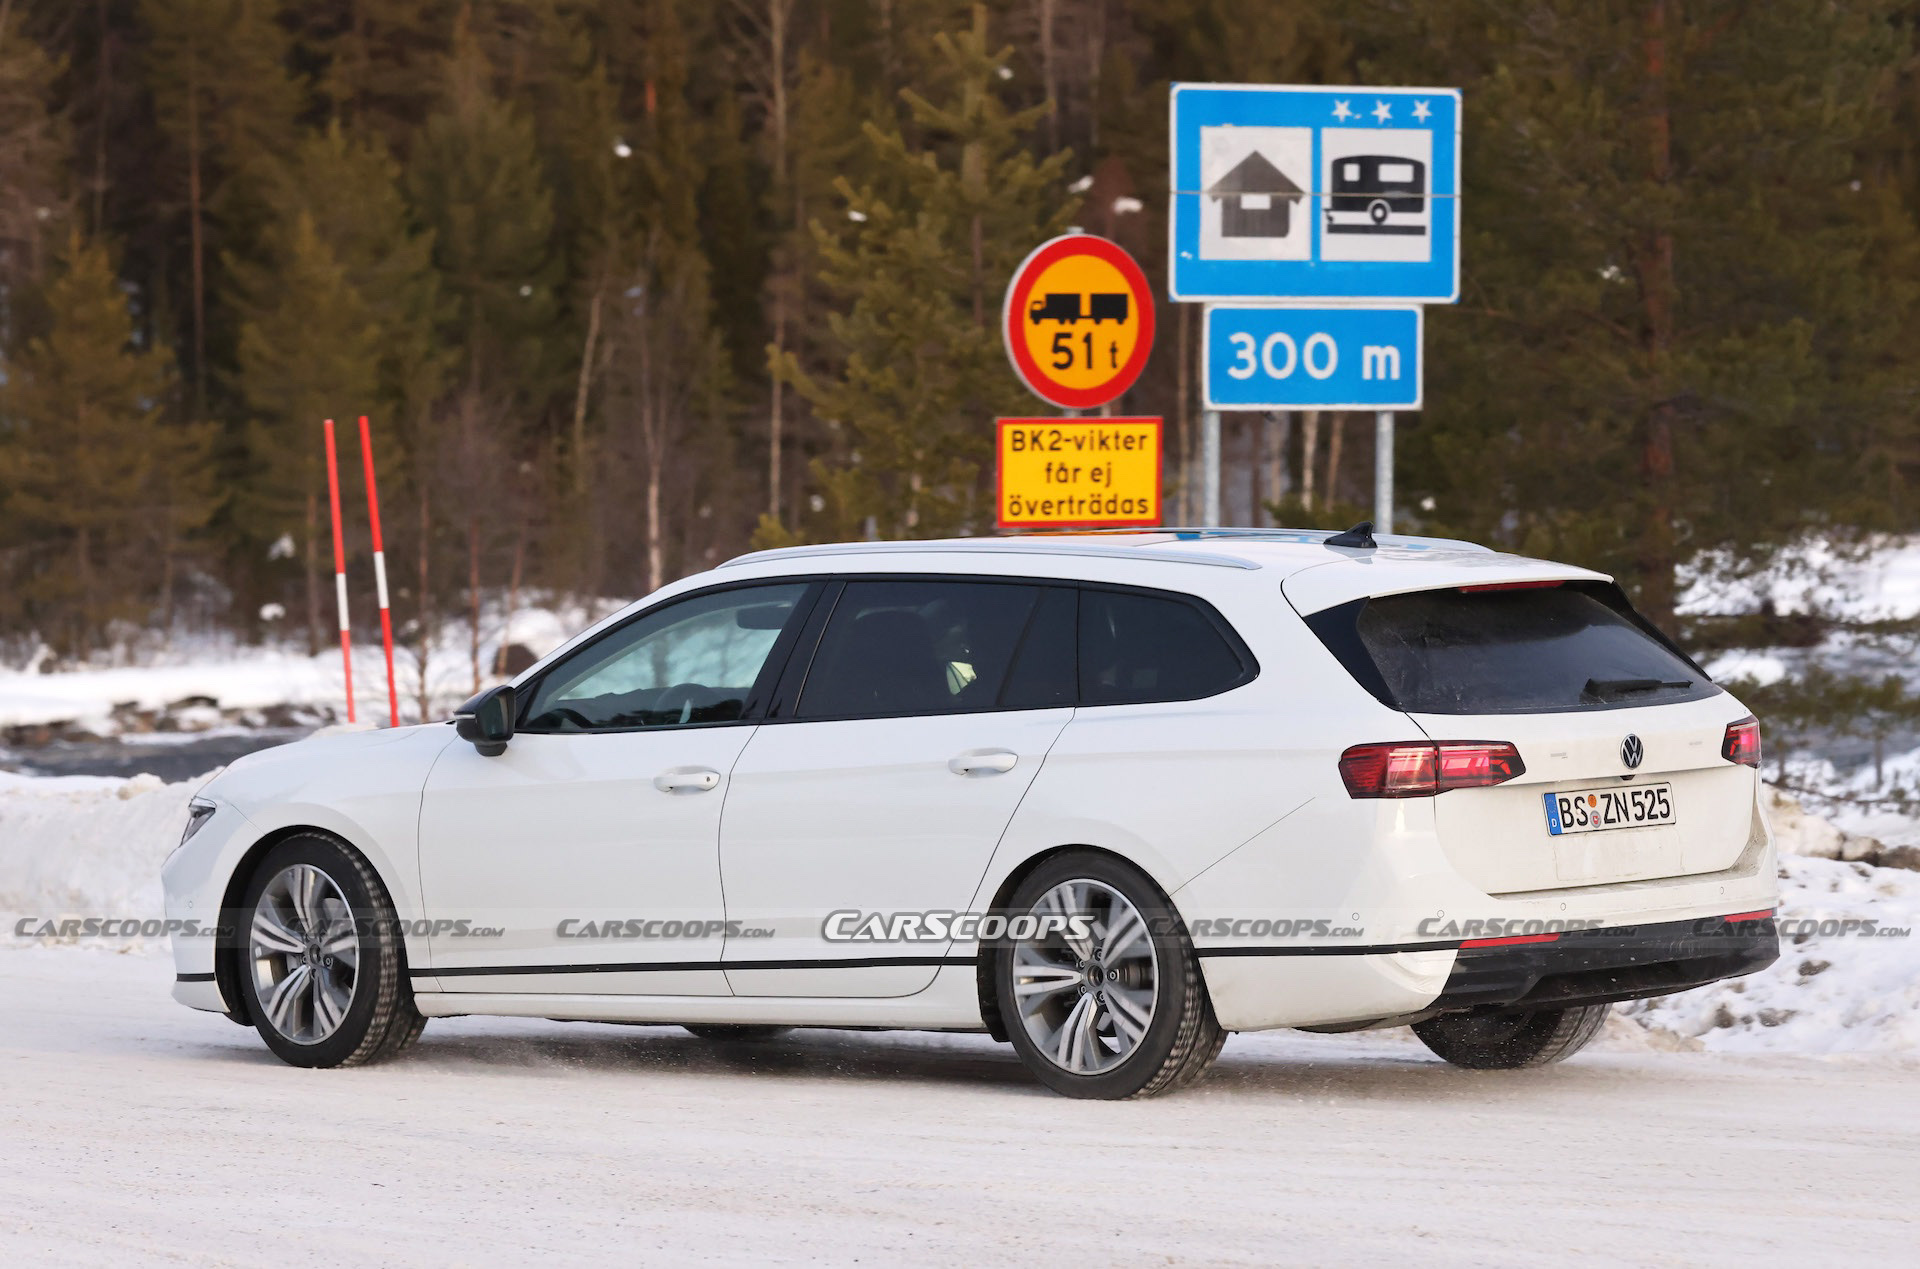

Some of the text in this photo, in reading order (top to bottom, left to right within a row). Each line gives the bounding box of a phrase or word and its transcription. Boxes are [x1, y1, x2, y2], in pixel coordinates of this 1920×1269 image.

[1052, 332, 1118, 370] 51 t
[1227, 331, 1400, 380] 300 m
[1011, 430, 1148, 451] BK2-vikter
[1045, 462, 1112, 488] får ej
[1009, 494, 1149, 516] överträdas
[1558, 788, 1671, 828] BS ZN 525
[1551, 818, 1558, 828] D
